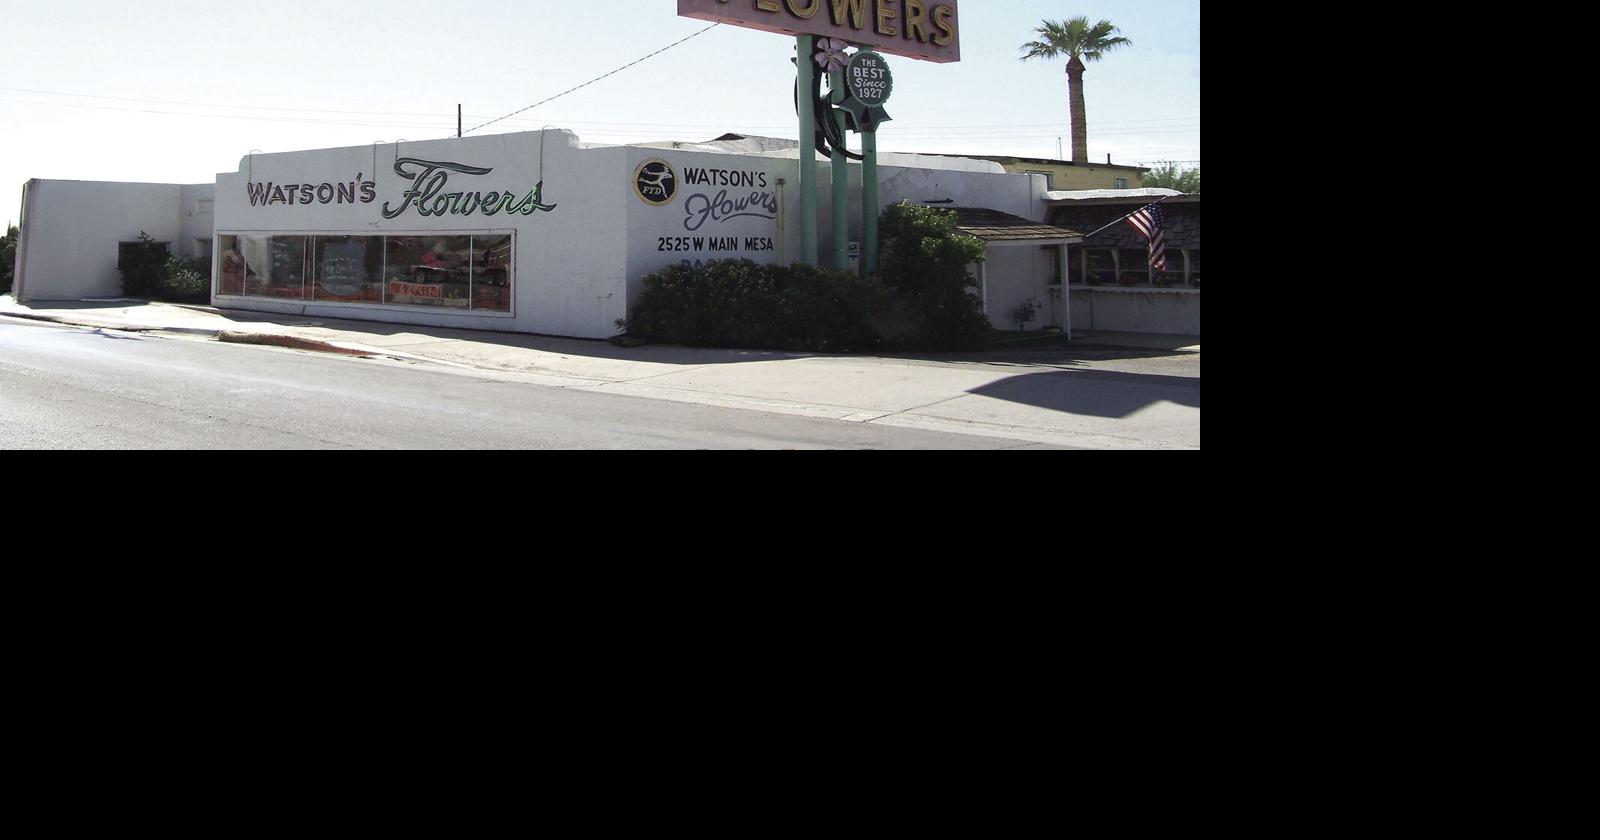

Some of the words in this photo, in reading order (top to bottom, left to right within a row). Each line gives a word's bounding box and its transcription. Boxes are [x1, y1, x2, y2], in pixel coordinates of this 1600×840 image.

[862, 59, 876, 67] THE
[853, 67, 885, 78] BEST
[854, 78, 887, 88] Since
[859, 88, 882, 98] 1927
[684, 167, 767, 188] WATSON'S
[247, 172, 377, 207] WATSON'S
[381, 157, 557, 219] Flowers
[642, 186, 662, 195] FTD
[658, 236, 690, 251] 2525
[693, 237, 704, 251] W
[709, 237, 738, 251] MAIN
[745, 237, 774, 251] MESA
